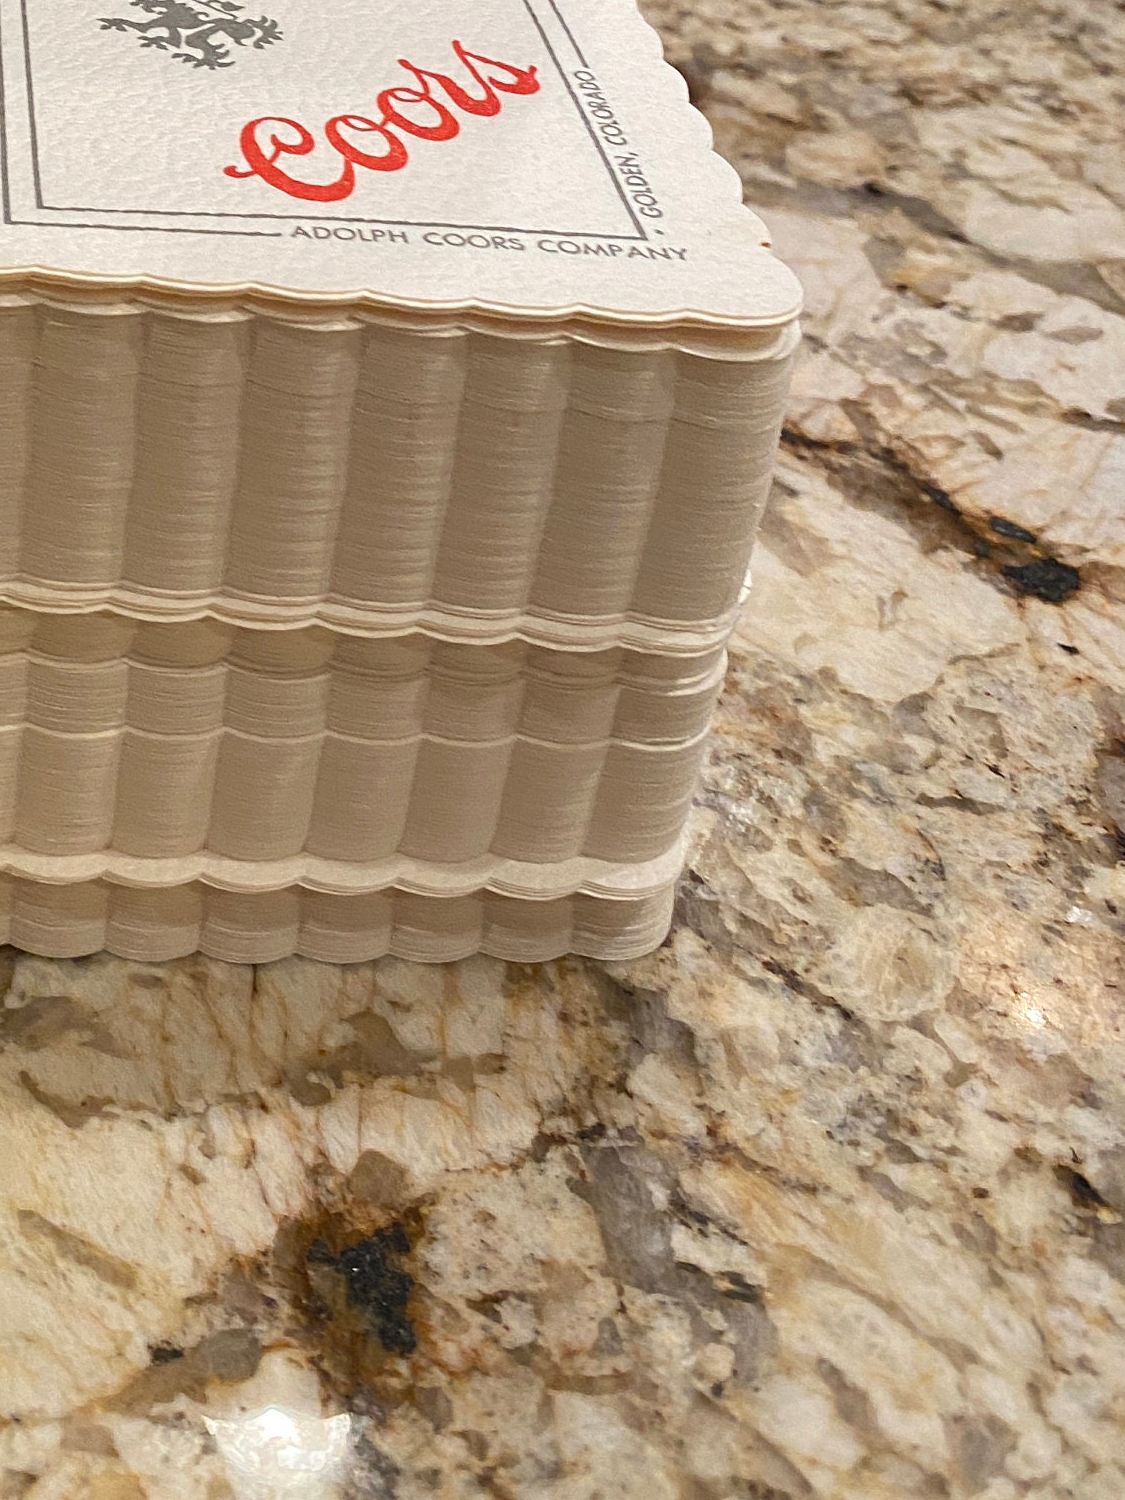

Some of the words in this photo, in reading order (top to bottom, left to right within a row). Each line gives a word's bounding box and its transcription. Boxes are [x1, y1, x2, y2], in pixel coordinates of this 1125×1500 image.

[222, 39, 541, 202] Coors
[573, 70, 627, 146] COLORADO
[613, 152, 664, 219] GOLDEN,
[290, 225, 410, 244] ADOLPH
[423, 232, 526, 252] COORS
[537, 239, 688, 261] COMPANY
